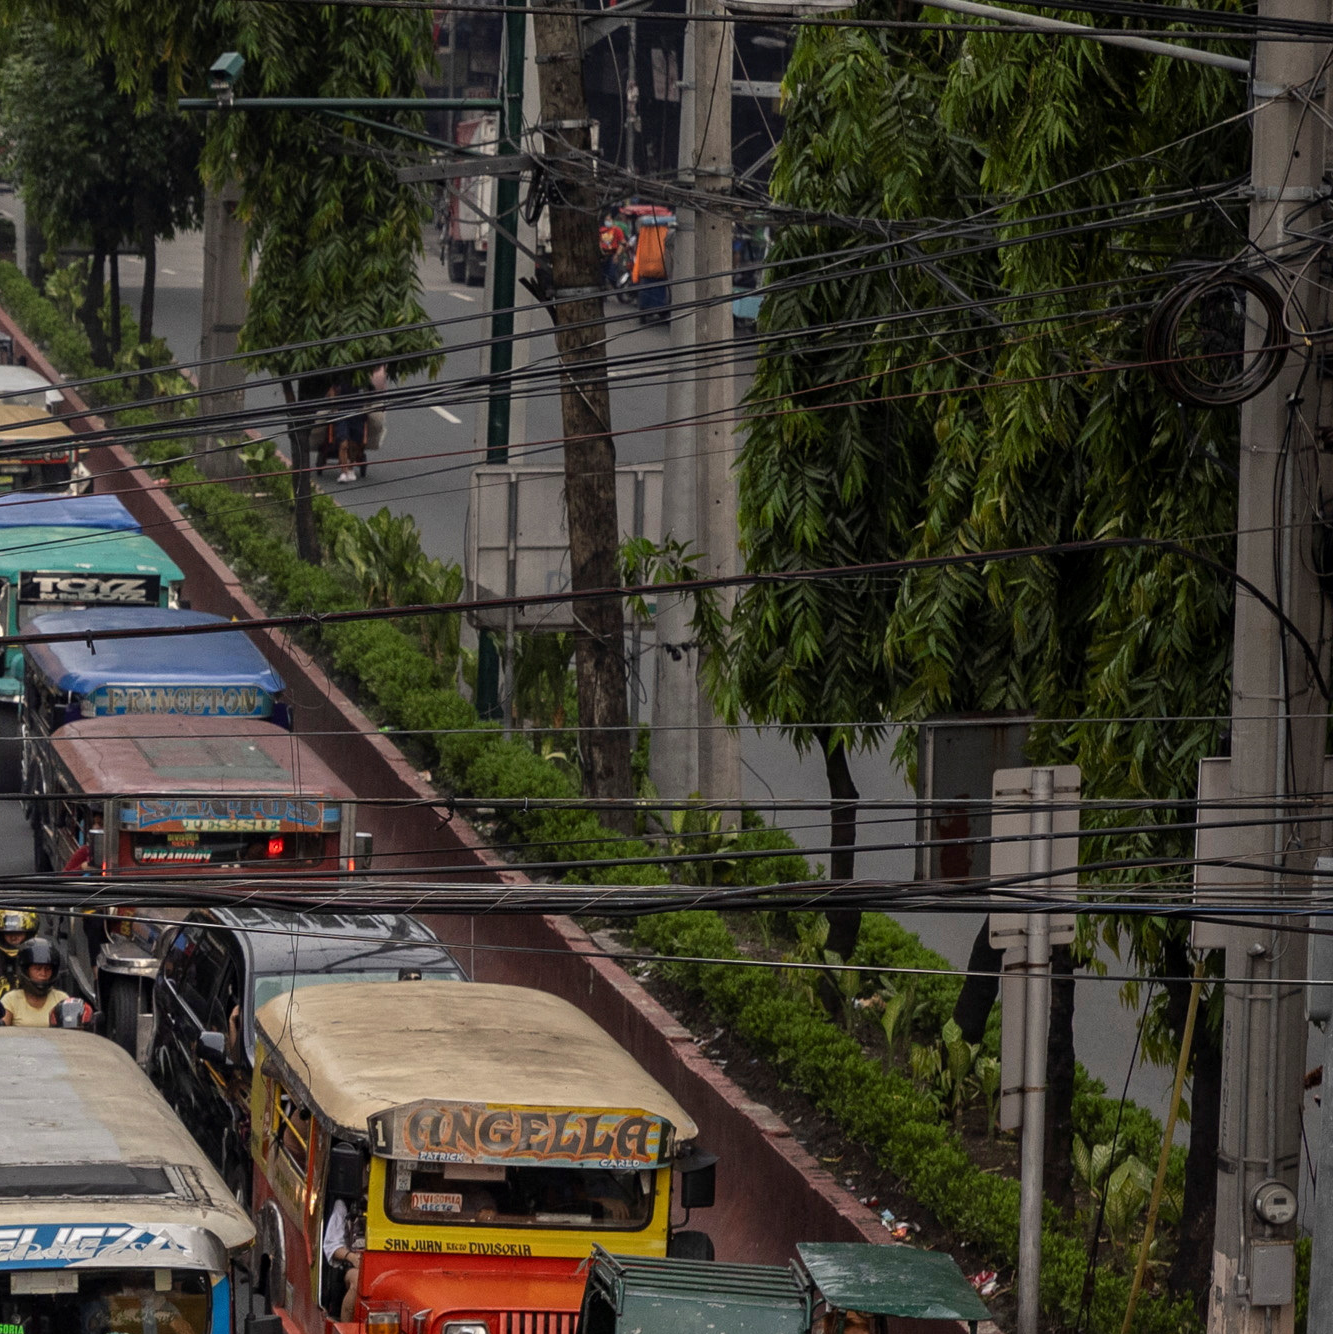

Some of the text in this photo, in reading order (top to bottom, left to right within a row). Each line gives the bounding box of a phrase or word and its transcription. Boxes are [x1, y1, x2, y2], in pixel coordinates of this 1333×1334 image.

[33, 577, 146, 593] TOYZ
[106, 688, 257, 713] PRINCETON
[375, 1120, 386, 1147] 1
[403, 1106, 651, 1161] ANGELLA
[418, 1151, 464, 1162] PATRICK
[599, 1158, 640, 1168] CARLO
[411, 1193, 462, 1207] DIVISORIA
[384, 1238, 410, 1251] SAN
[411, 1239, 443, 1252] JUAN
[468, 1241, 532, 1257] DIVISORIA
